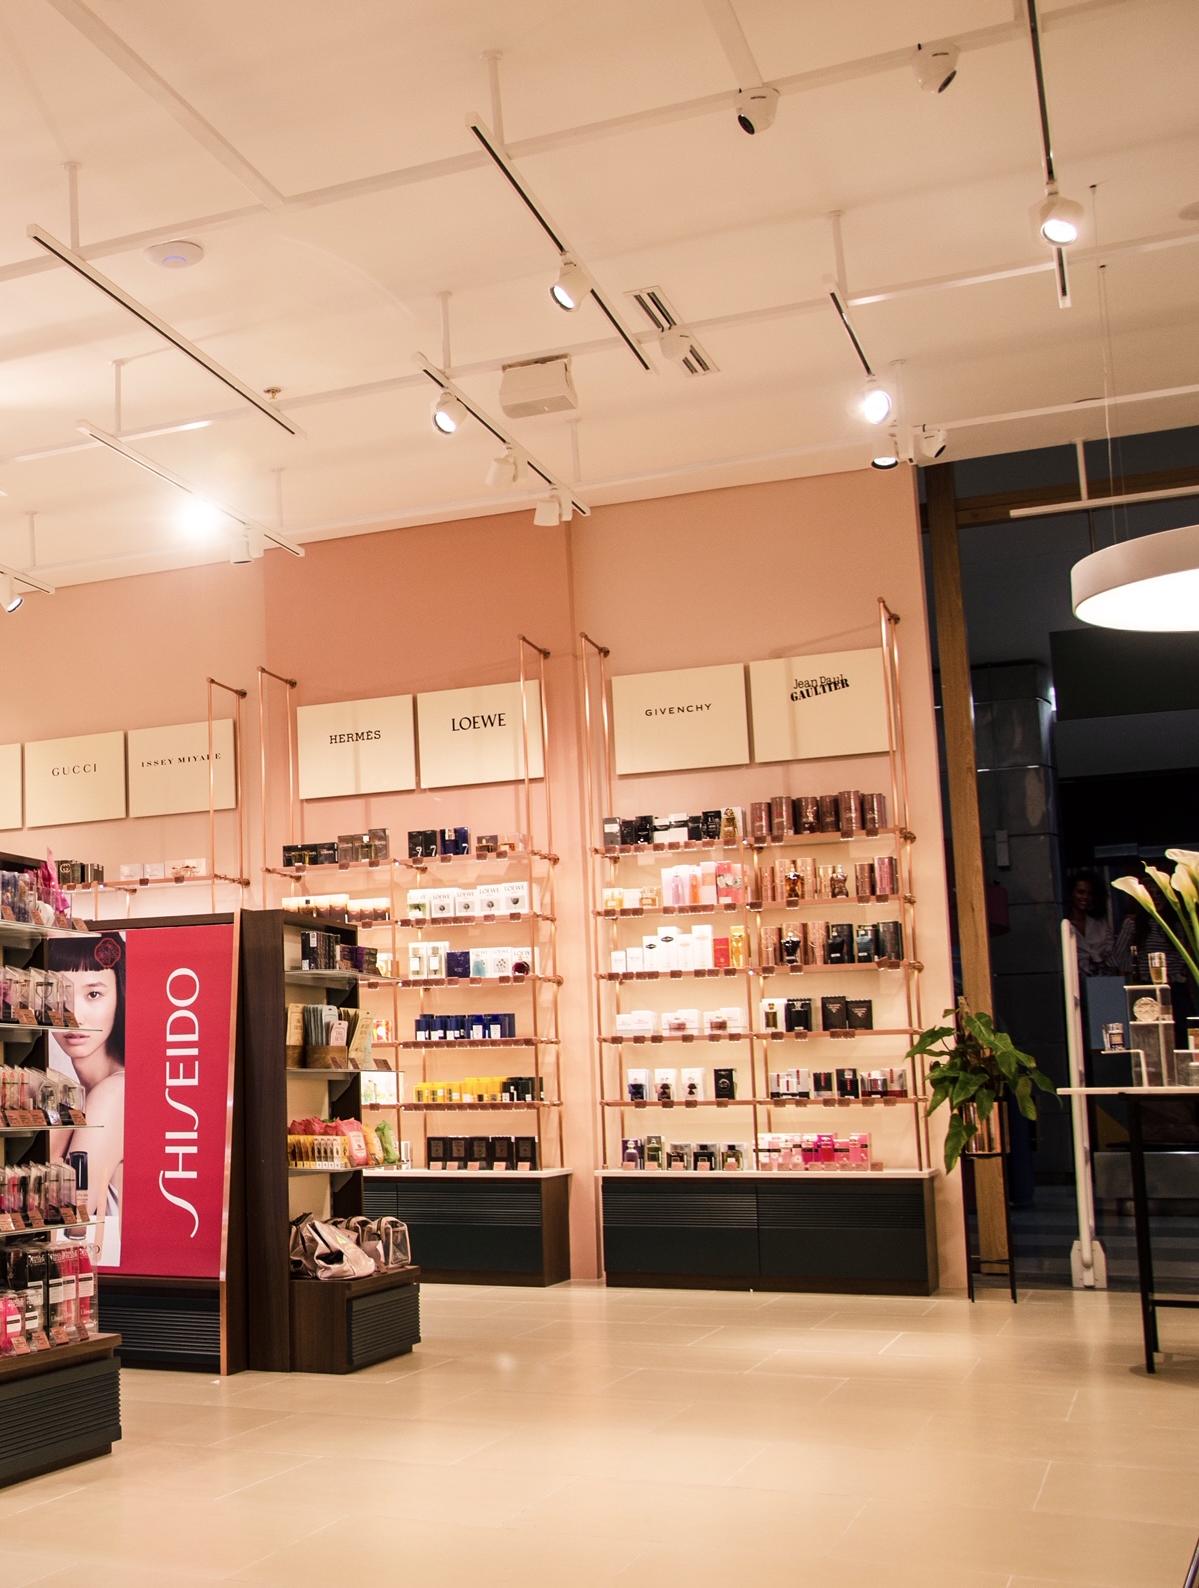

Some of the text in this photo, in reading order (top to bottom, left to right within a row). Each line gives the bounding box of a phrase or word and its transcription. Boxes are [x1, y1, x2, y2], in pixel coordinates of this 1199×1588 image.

[790, 678, 850, 702] GAULTIER
[793, 678, 819, 690] Jean
[644, 703, 713, 717] GIVENCHY
[451, 712, 507, 732] LOEWE
[328, 730, 382, 745] HERMÈS
[51, 763, 98, 777] GUCCI
[141, 758, 174, 768] ISSEY
[159, 968, 199, 1238] SHISEIDO
